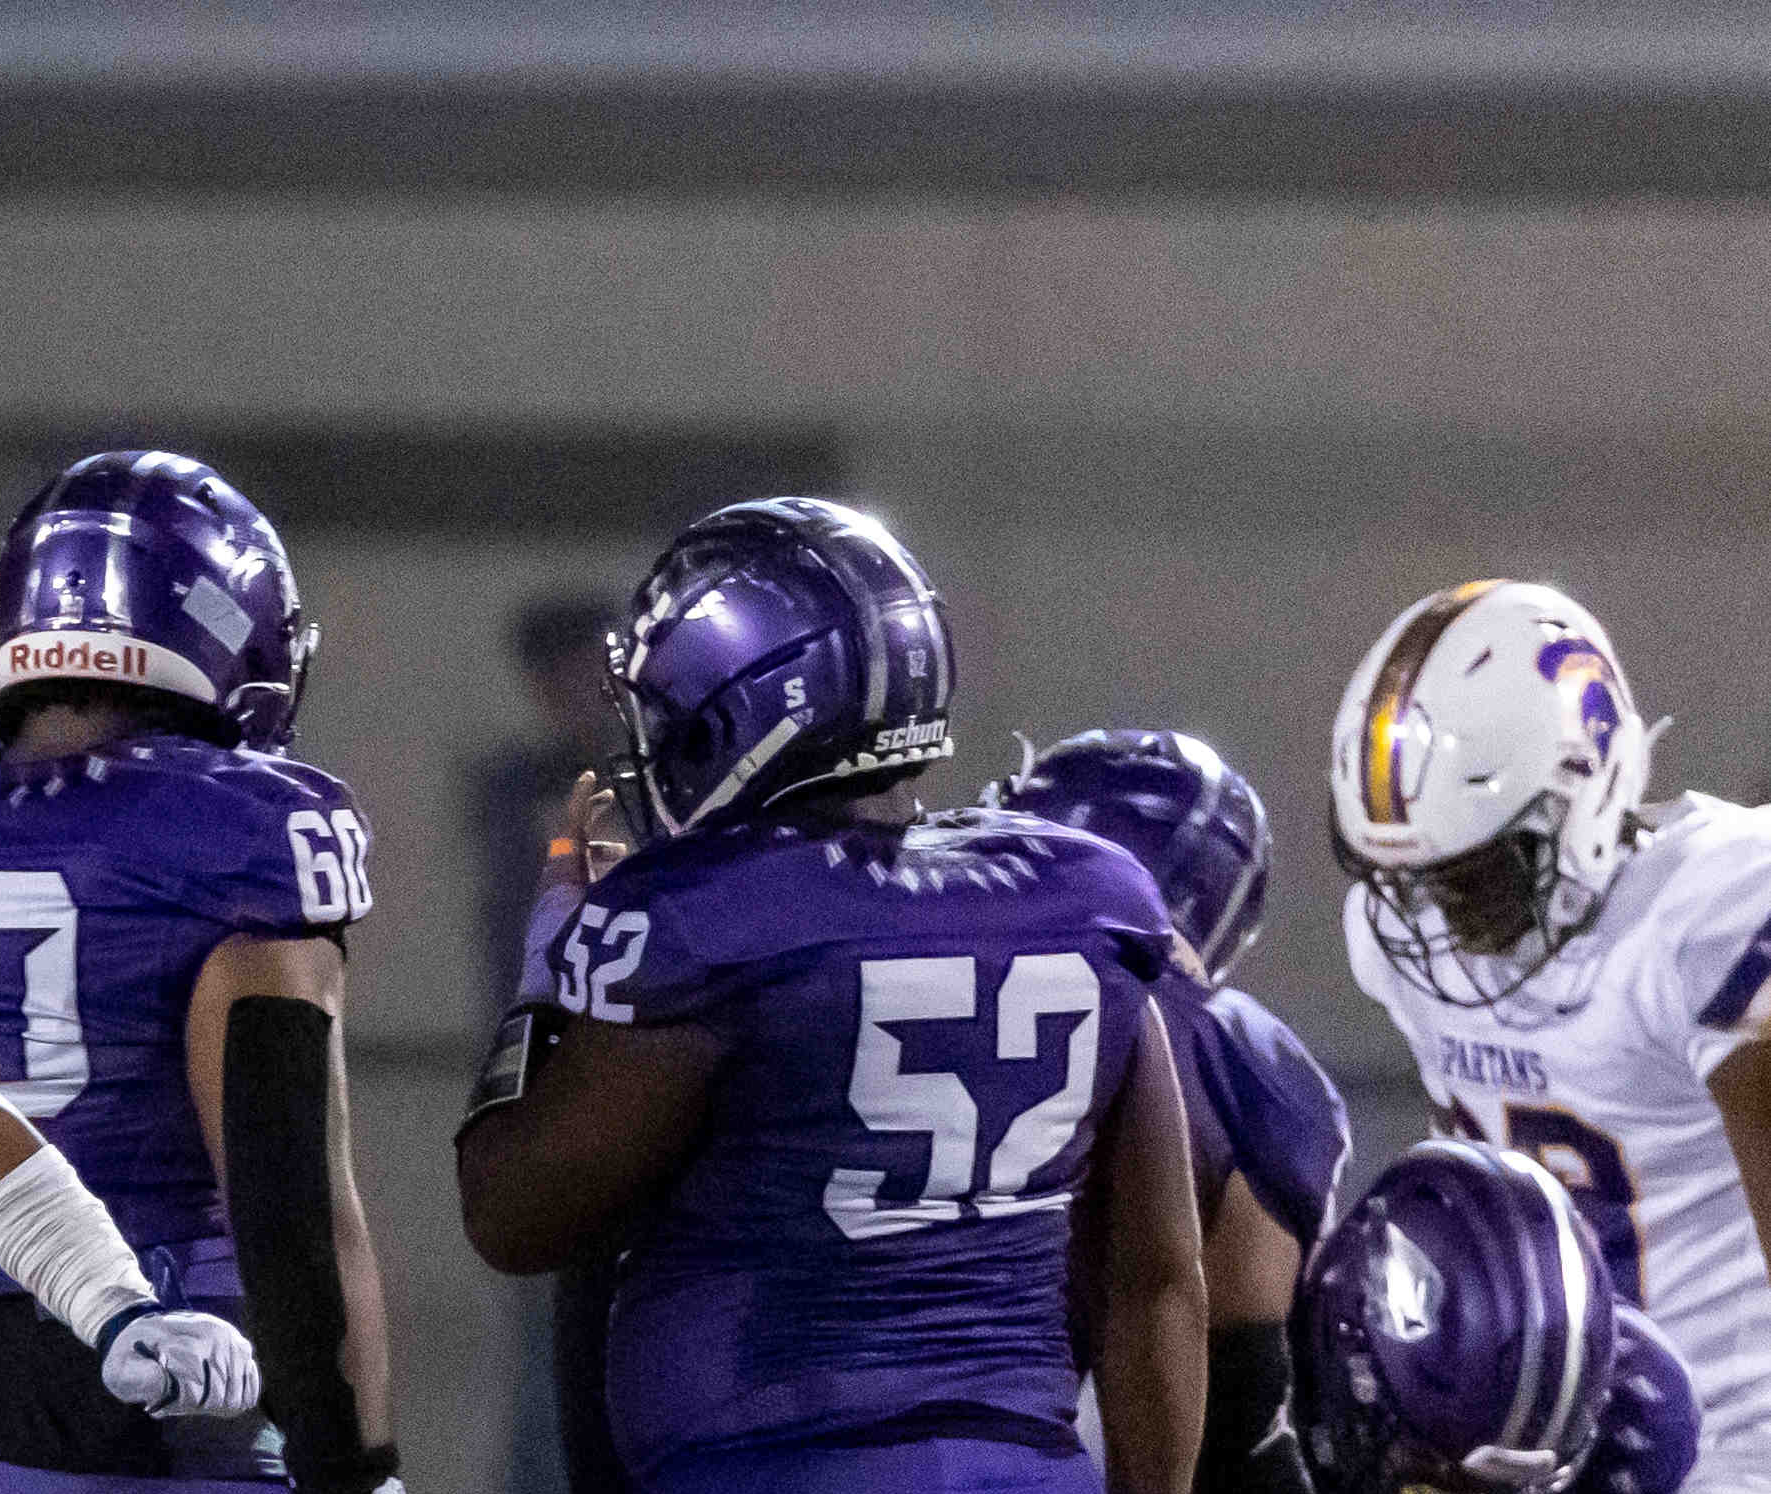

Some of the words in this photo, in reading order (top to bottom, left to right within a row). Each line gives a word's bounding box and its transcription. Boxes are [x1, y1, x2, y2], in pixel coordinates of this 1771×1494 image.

[11, 640, 147, 676] Riddell
[784, 676, 806, 709] S
[286, 808, 374, 924] 60
[558, 902, 651, 1024] 52
[822, 951, 1102, 1241] 52
